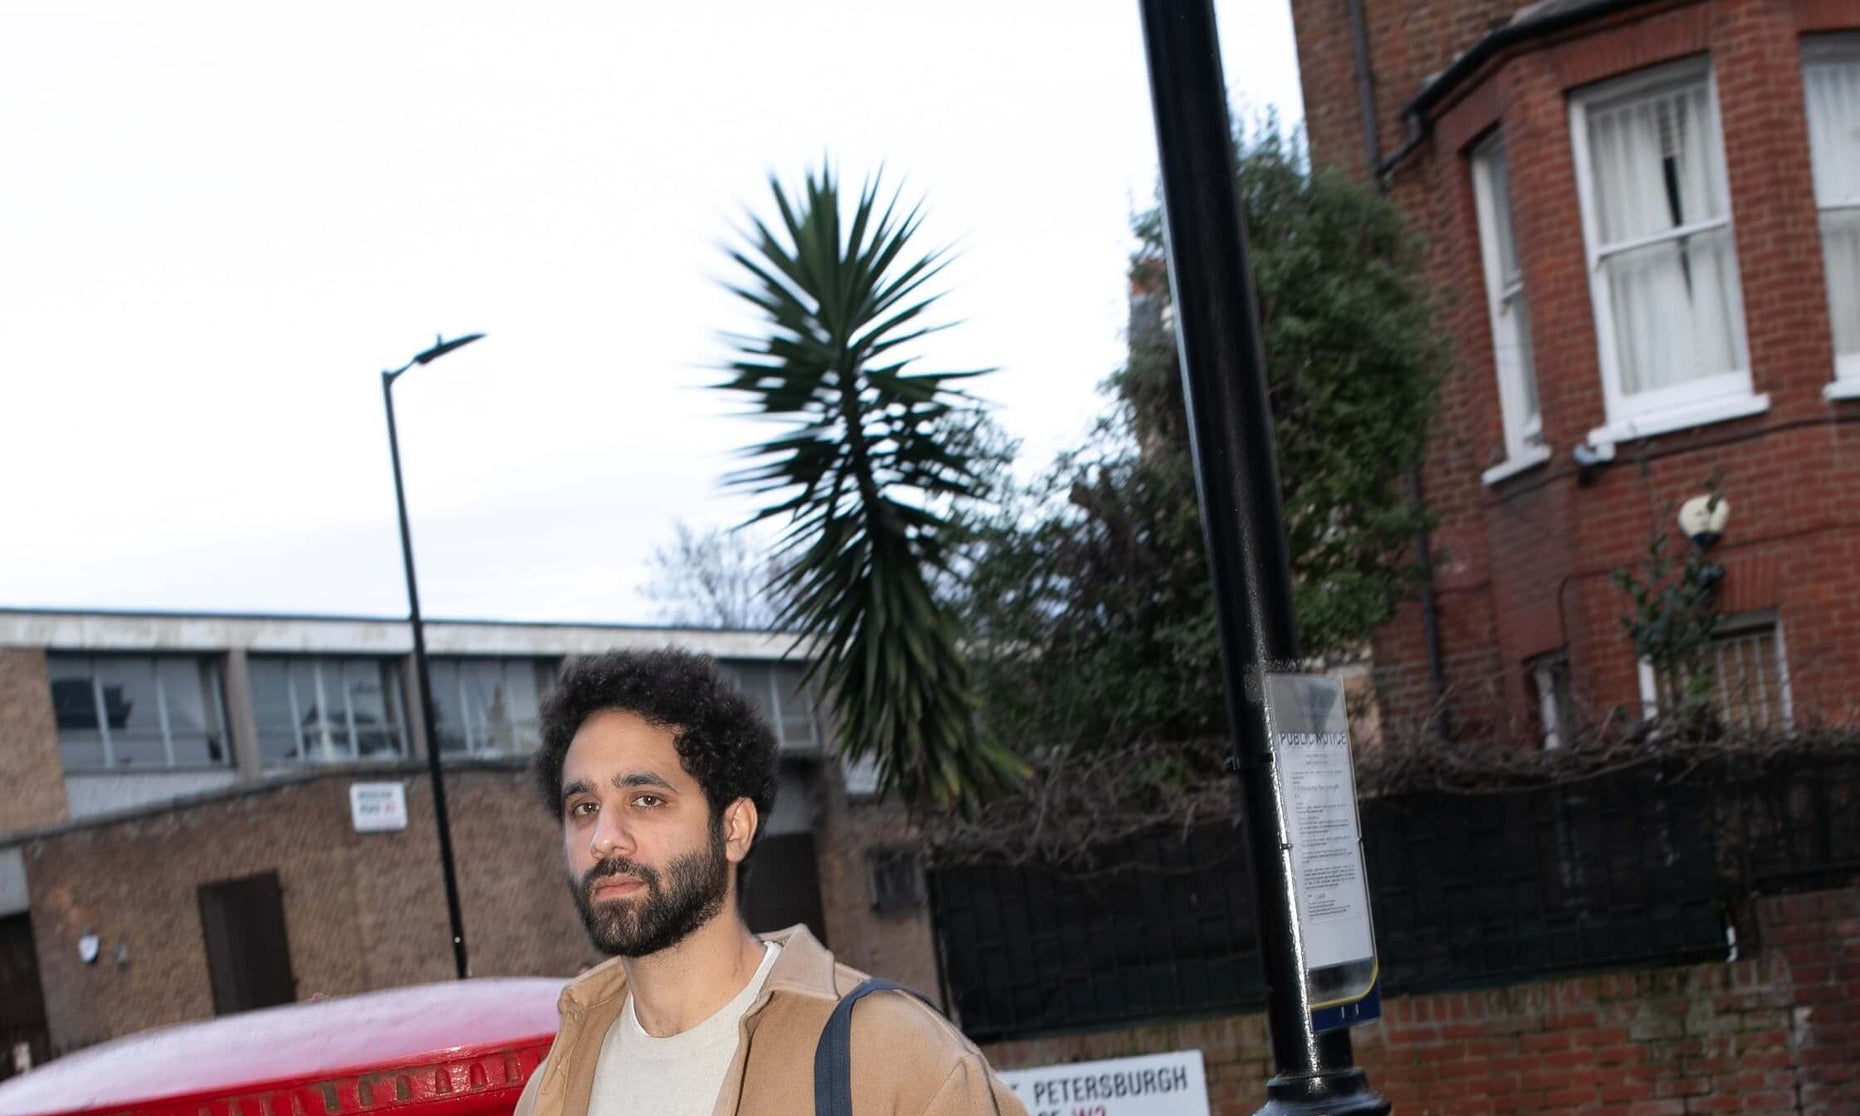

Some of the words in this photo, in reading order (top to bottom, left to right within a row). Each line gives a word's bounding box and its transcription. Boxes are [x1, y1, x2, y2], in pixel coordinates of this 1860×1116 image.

[1280, 730, 1314, 746] PUBLIC
[1315, 730, 1346, 746] NOTICE
[1034, 1065, 1188, 1105] PETERSBURGH
